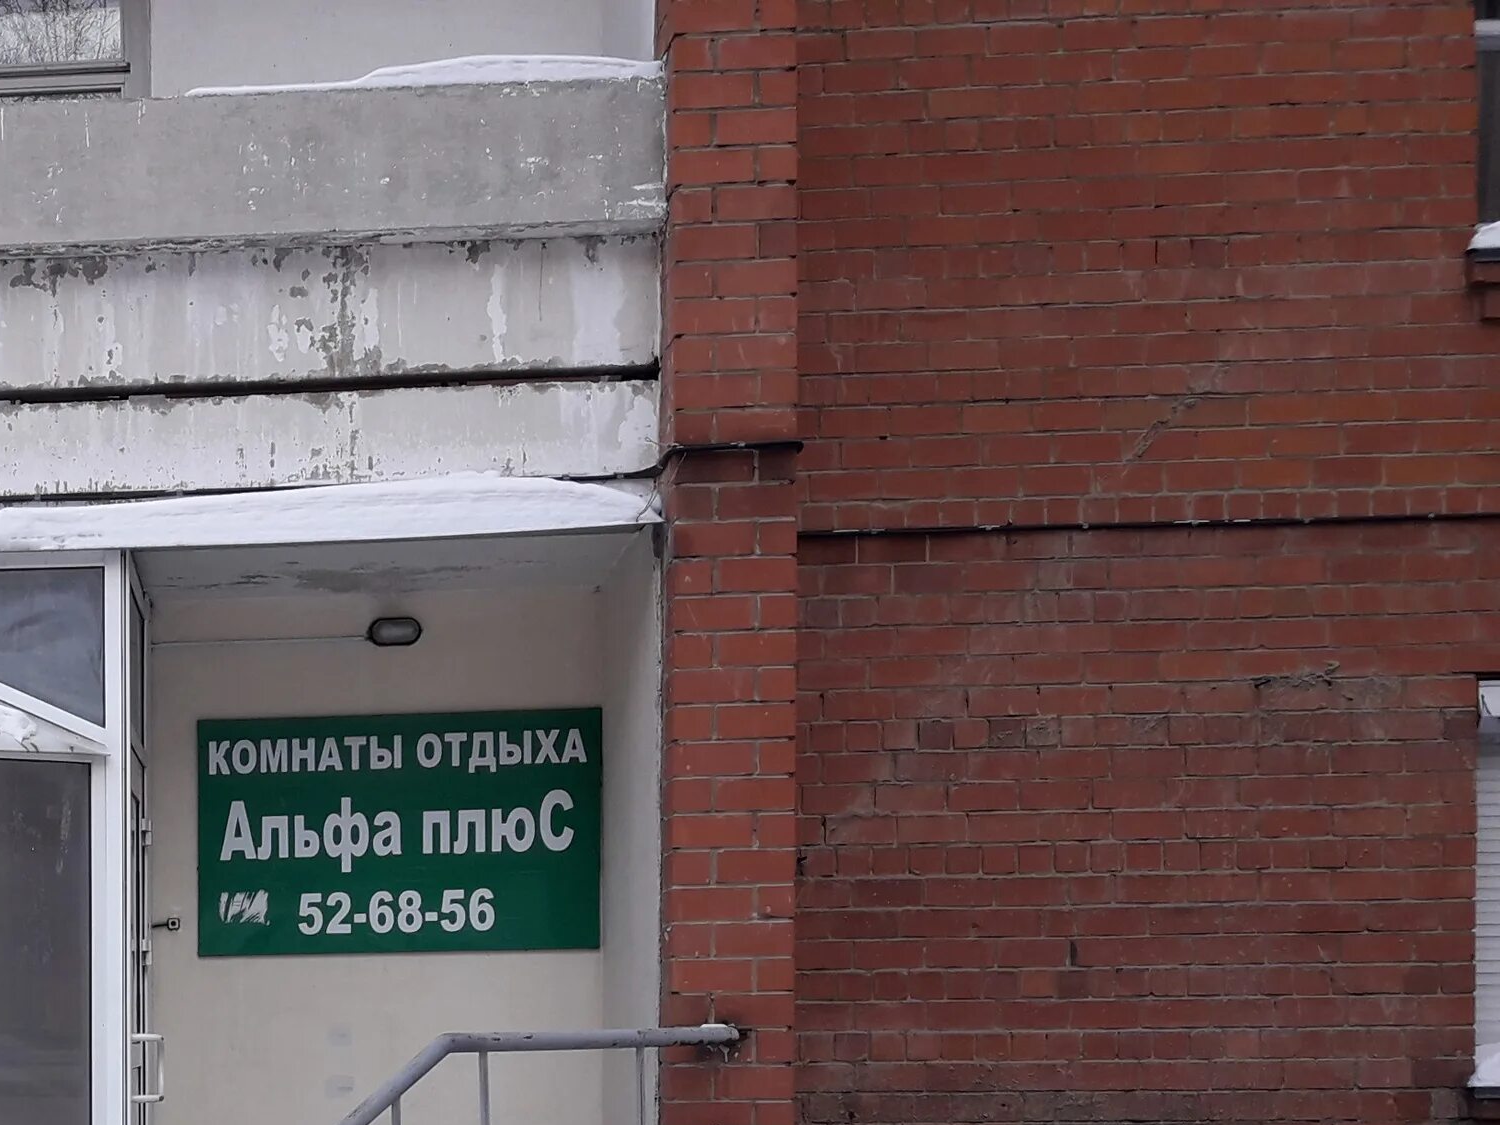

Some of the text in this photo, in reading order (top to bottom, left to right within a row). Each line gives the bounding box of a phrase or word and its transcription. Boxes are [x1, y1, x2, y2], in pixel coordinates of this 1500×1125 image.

[208, 728, 588, 776] КОМНАТЫ ОТДЫХА
[219, 789, 575, 873] Альфа плюС
[298, 887, 496, 936] 52-68-56
